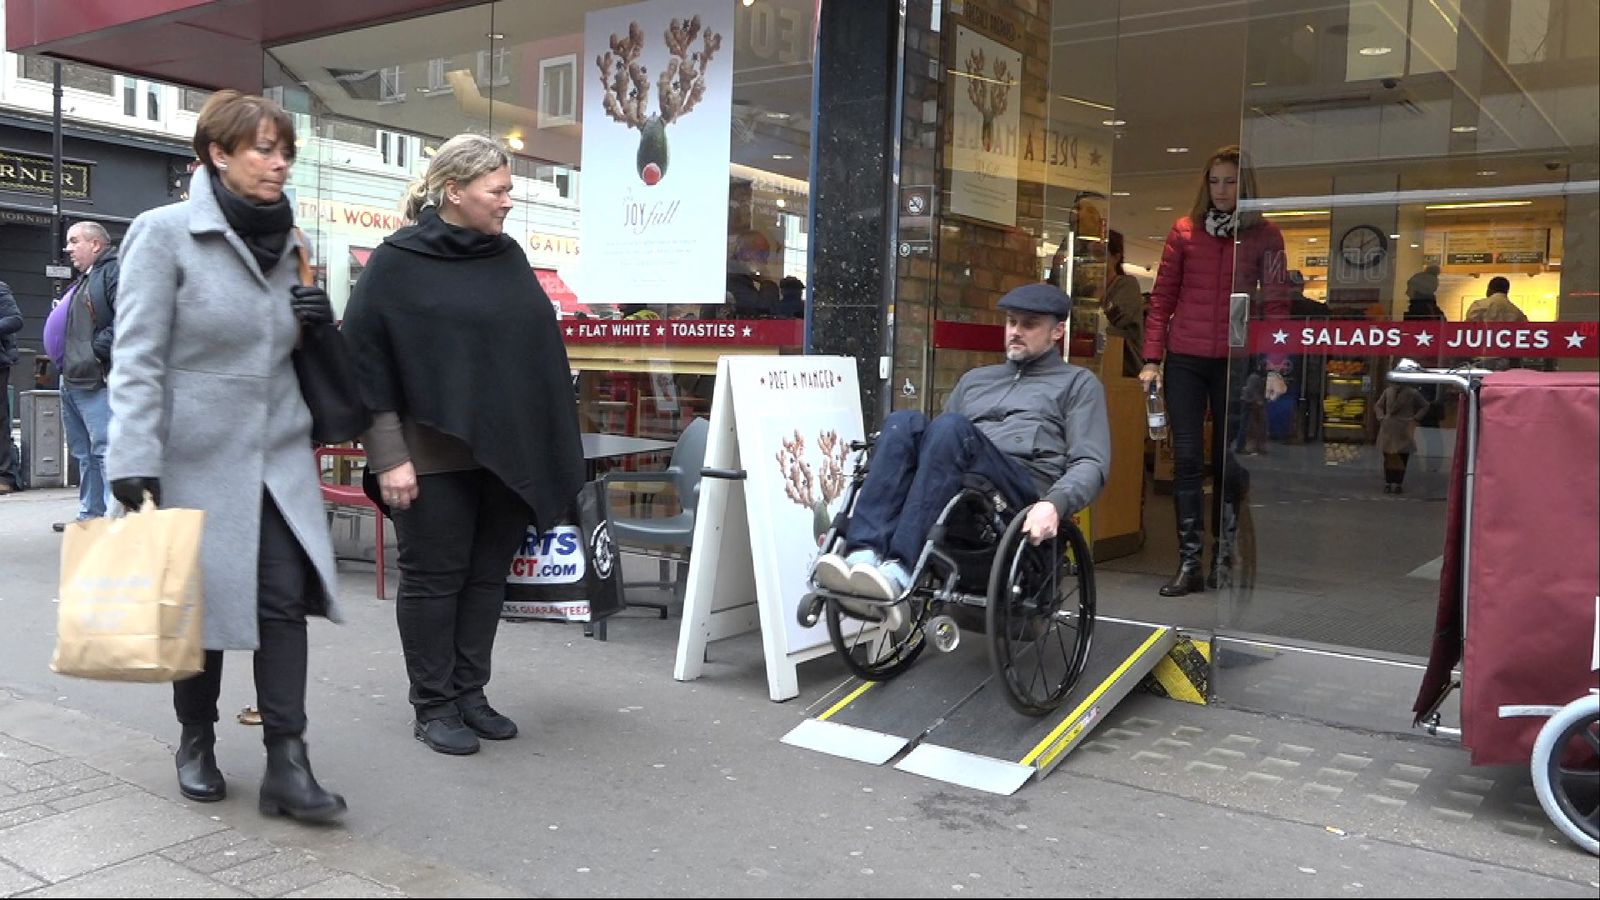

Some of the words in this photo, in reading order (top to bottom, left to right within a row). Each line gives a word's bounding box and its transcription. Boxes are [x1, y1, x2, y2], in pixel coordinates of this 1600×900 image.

[579, 324, 608, 337] FLAT
[612, 324, 650, 337] WHITE
[671, 323, 735, 338] TOASTIES
[1300, 327, 1401, 346] SALADS
[1447, 329, 1549, 348] JUICES
[792, 372, 798, 388] A
[800, 369, 835, 389] MANGER
